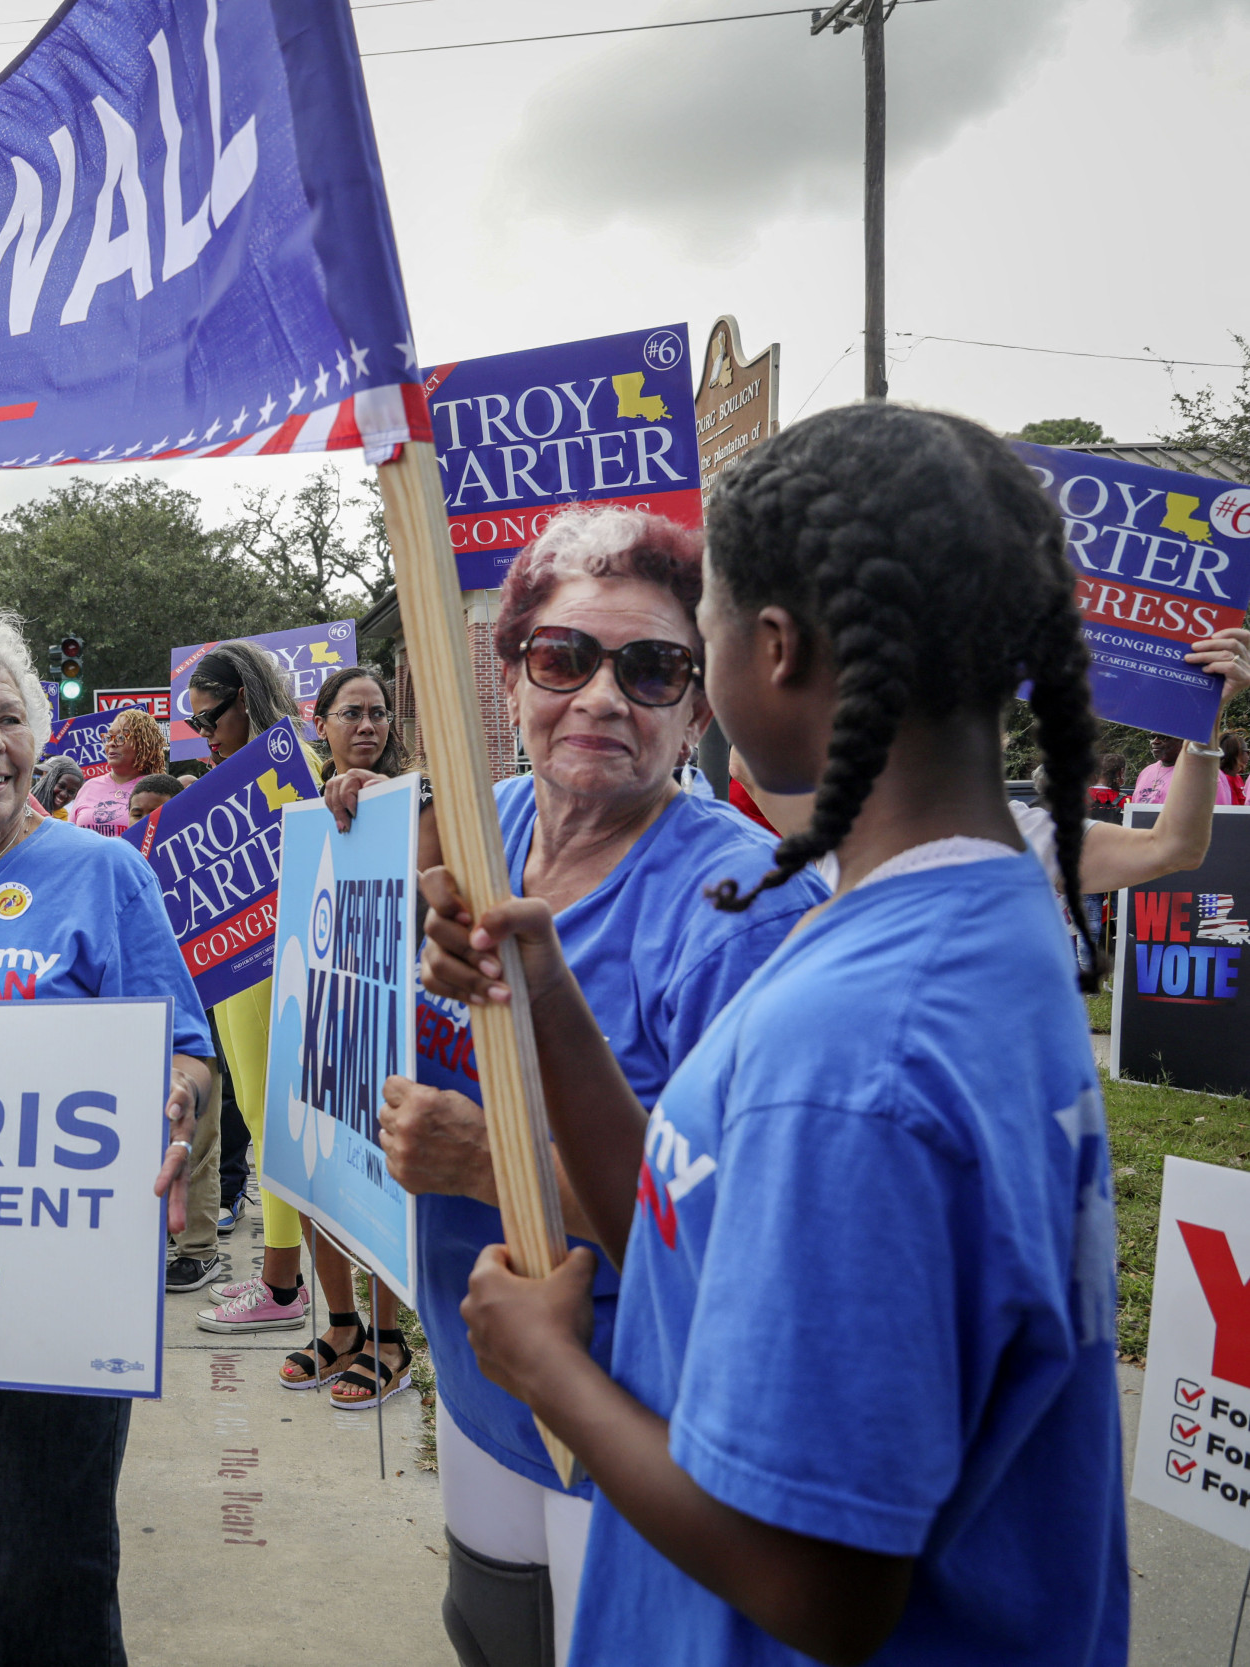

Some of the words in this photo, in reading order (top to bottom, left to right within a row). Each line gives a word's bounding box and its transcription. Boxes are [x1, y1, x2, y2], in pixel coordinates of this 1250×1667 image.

[647, 336, 676, 364] #6
[433, 377, 606, 451] TROY
[719, 378, 761, 421] BOULIGNY
[714, 433, 748, 468] plantation
[751, 421, 761, 441] of
[331, 624, 347, 638] #6
[175, 648, 206, 674] RE-ELECT
[1101, 654, 1137, 669] CARTER
[1138, 664, 1157, 674] FOR
[1158, 669, 1209, 687] CONGRESS
[68, 723, 113, 748] TRO
[270, 731, 289, 755] #6
[156, 781, 260, 884] TROY
[332, 879, 382, 981] KREWE
[383, 878, 404, 986] OF
[1135, 892, 1192, 942] WE
[1136, 944, 1241, 998] VOTE
[301, 967, 398, 1153] KAMALA
[366, 1148, 382, 1190] WIN
[1210, 1396, 1250, 1431] Fo
